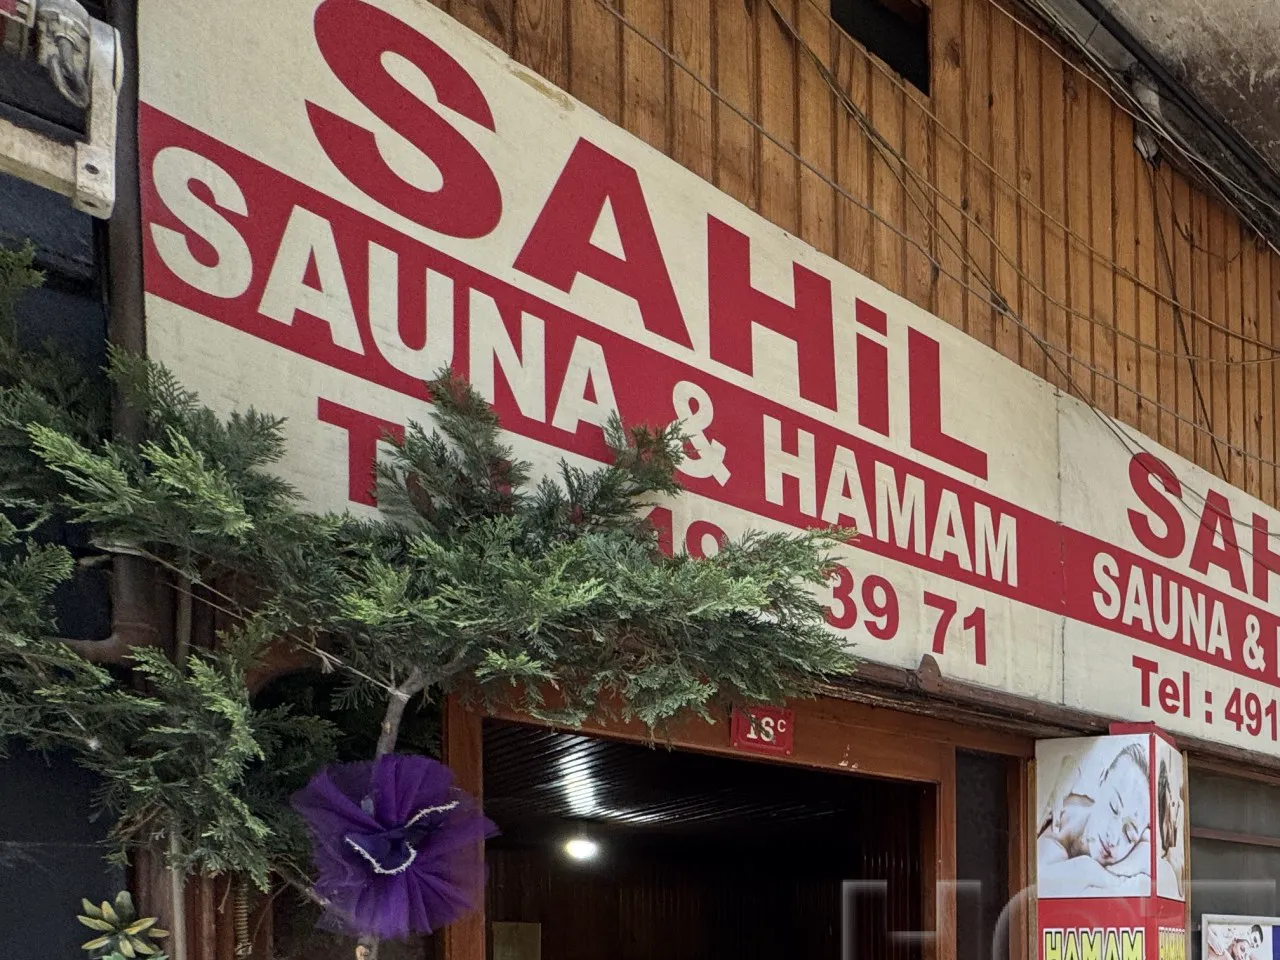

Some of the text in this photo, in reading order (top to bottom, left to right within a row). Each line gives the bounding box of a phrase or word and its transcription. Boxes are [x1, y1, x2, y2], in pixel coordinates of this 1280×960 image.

[151, 146, 624, 440] SAUNA
[672, 380, 731, 487] &
[763, 413, 1018, 588] HAMAM
[824, 562, 987, 666] 39 71
[1092, 552, 1231, 661] SAUNA
[1242, 613, 1266, 672] &
[1131, 656, 1192, 716] Tel
[1224, 688, 1280, 742] 491
